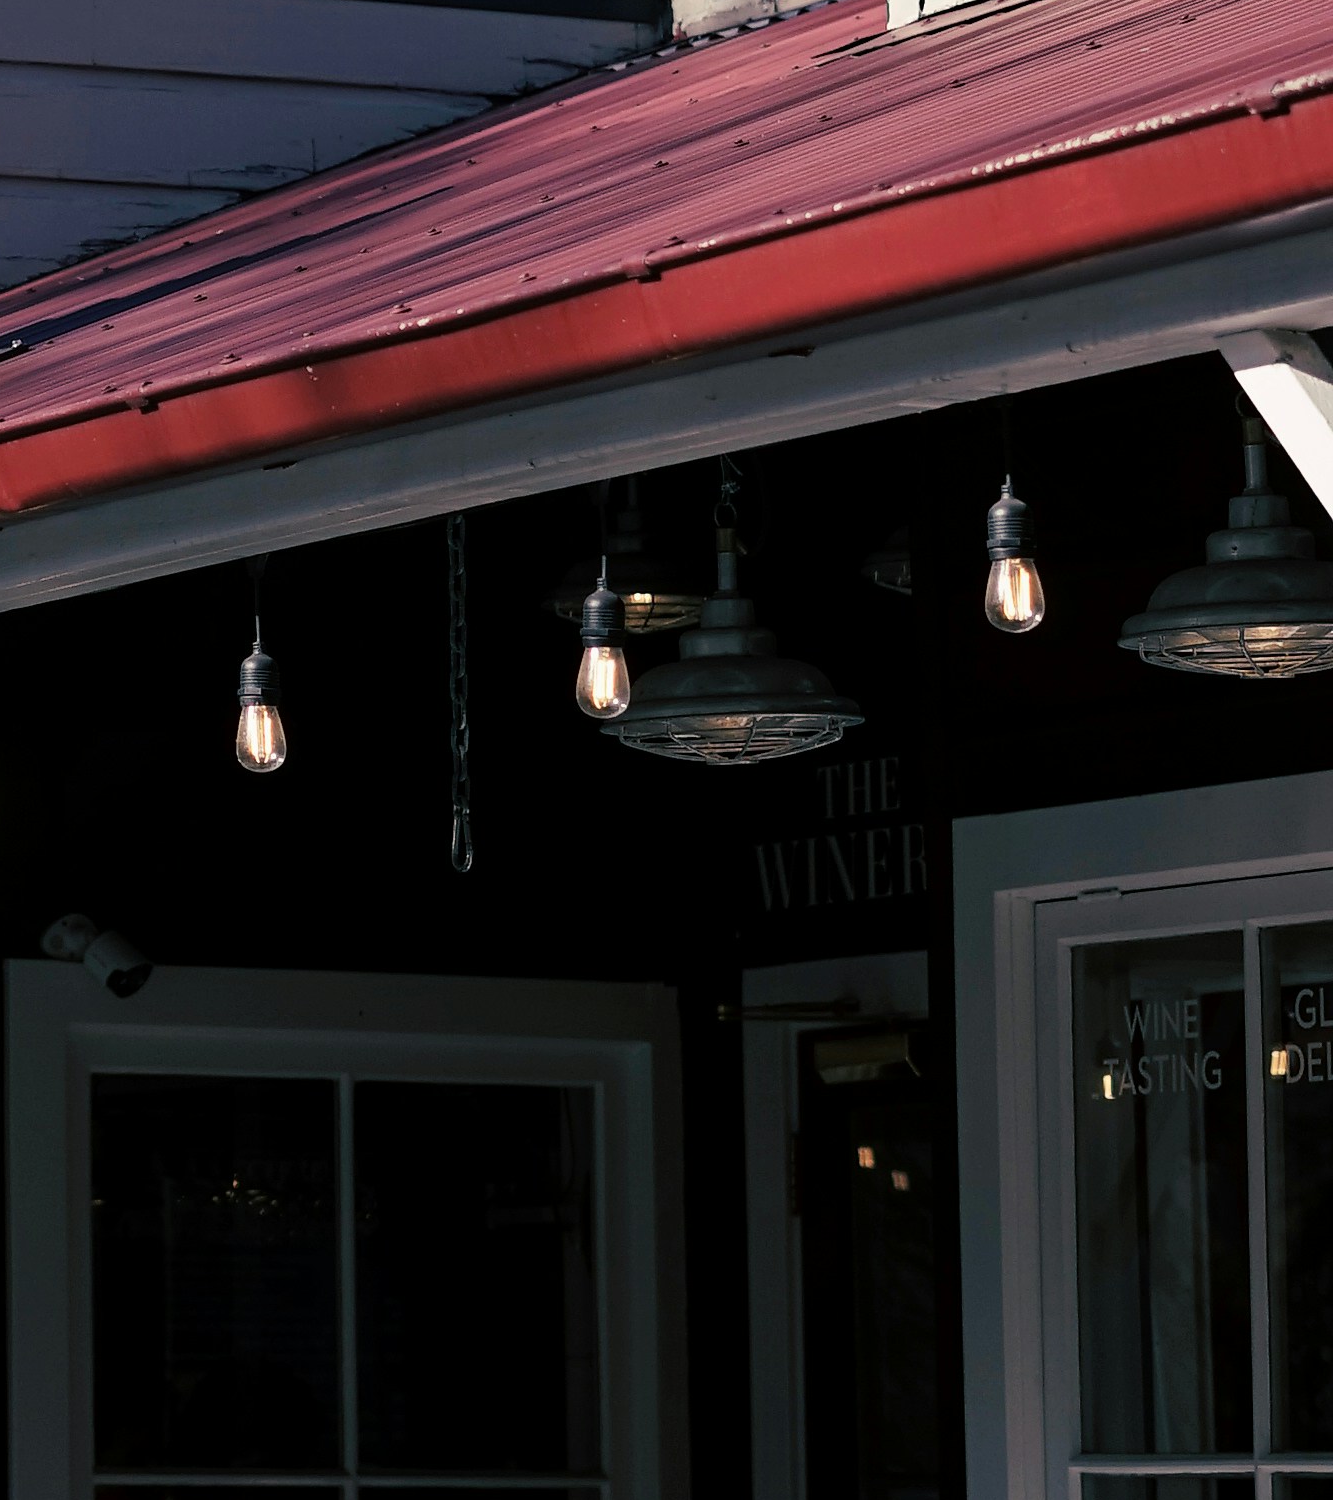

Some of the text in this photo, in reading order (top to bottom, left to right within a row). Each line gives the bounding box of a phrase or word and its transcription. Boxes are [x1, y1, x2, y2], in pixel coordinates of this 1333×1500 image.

[814, 756, 899, 819] THE
[1123, 998, 1200, 1044] WINE
[1102, 1050, 1223, 1097] TASTING
